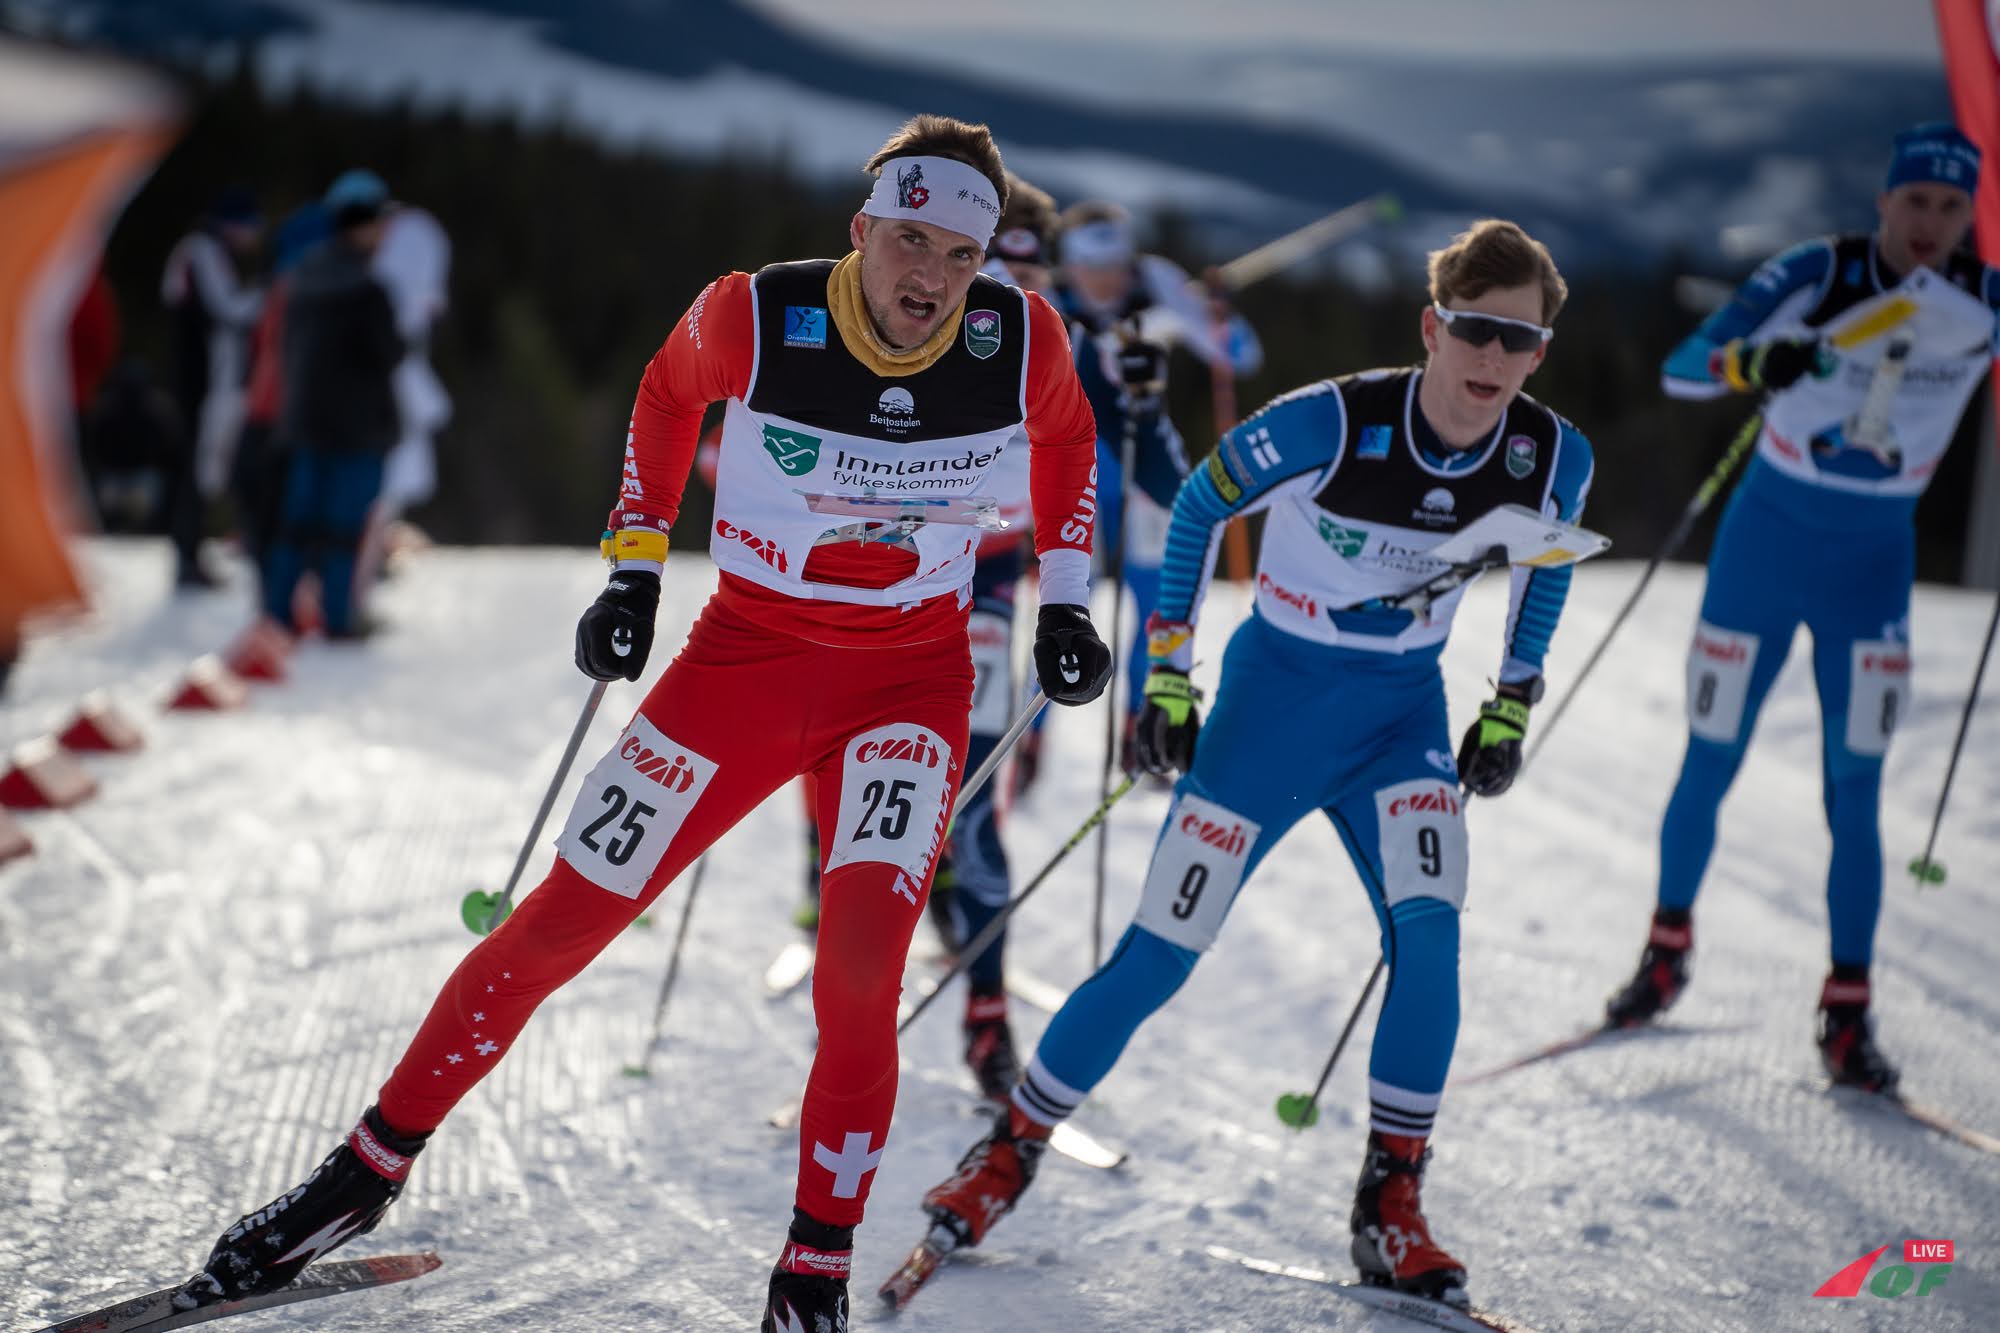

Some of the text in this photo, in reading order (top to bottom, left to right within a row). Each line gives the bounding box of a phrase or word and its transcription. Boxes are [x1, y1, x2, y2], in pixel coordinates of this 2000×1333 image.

[715, 518, 789, 574] emit
[619, 735, 696, 794] emit
[855, 733, 940, 769] emit
[578, 784, 658, 867] 25
[851, 779, 917, 843] 25
[1418, 825, 1442, 878] 9
[1171, 862, 1210, 921] 9
